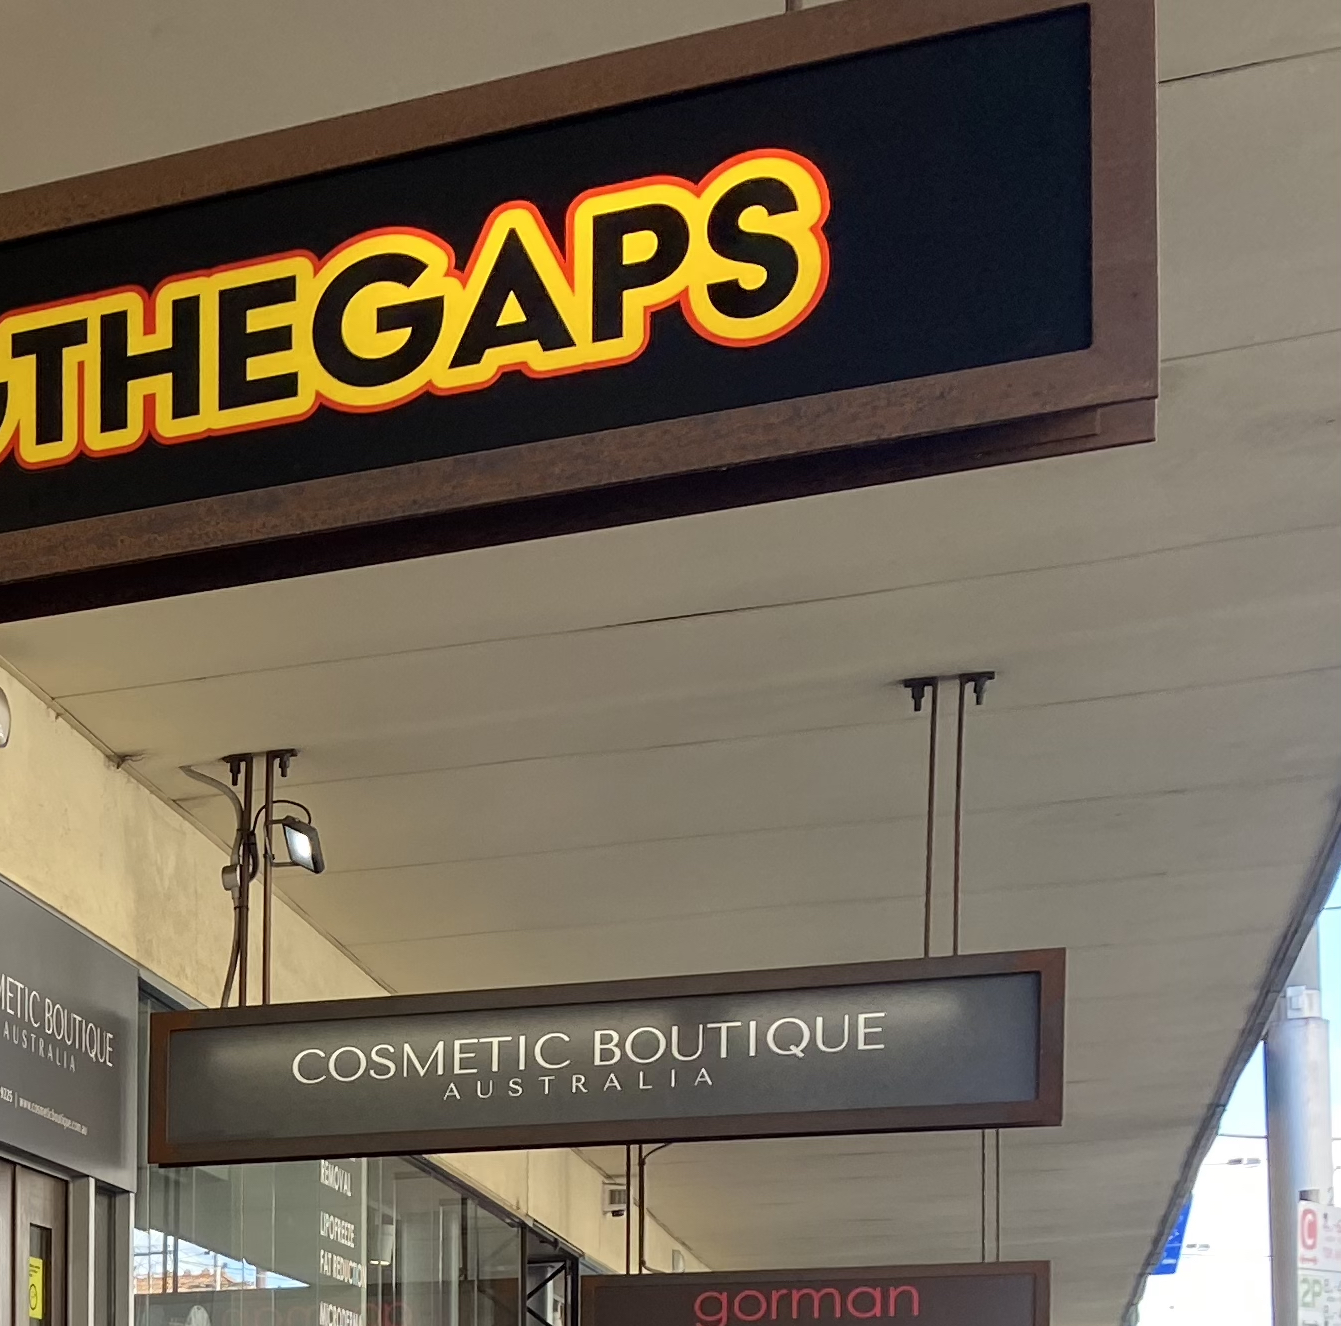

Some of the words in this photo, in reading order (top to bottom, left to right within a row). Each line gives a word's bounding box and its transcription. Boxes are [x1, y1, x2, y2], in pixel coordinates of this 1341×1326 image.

[3, 1020, 77, 1073] AUSTRALIA
[44, 997, 114, 1068] BOUTIQUE
[292, 1031, 571, 1085] COSMETIC
[592, 1010, 886, 1067] BOUTIQUE
[443, 1066, 714, 1101] AUSTRALIA
